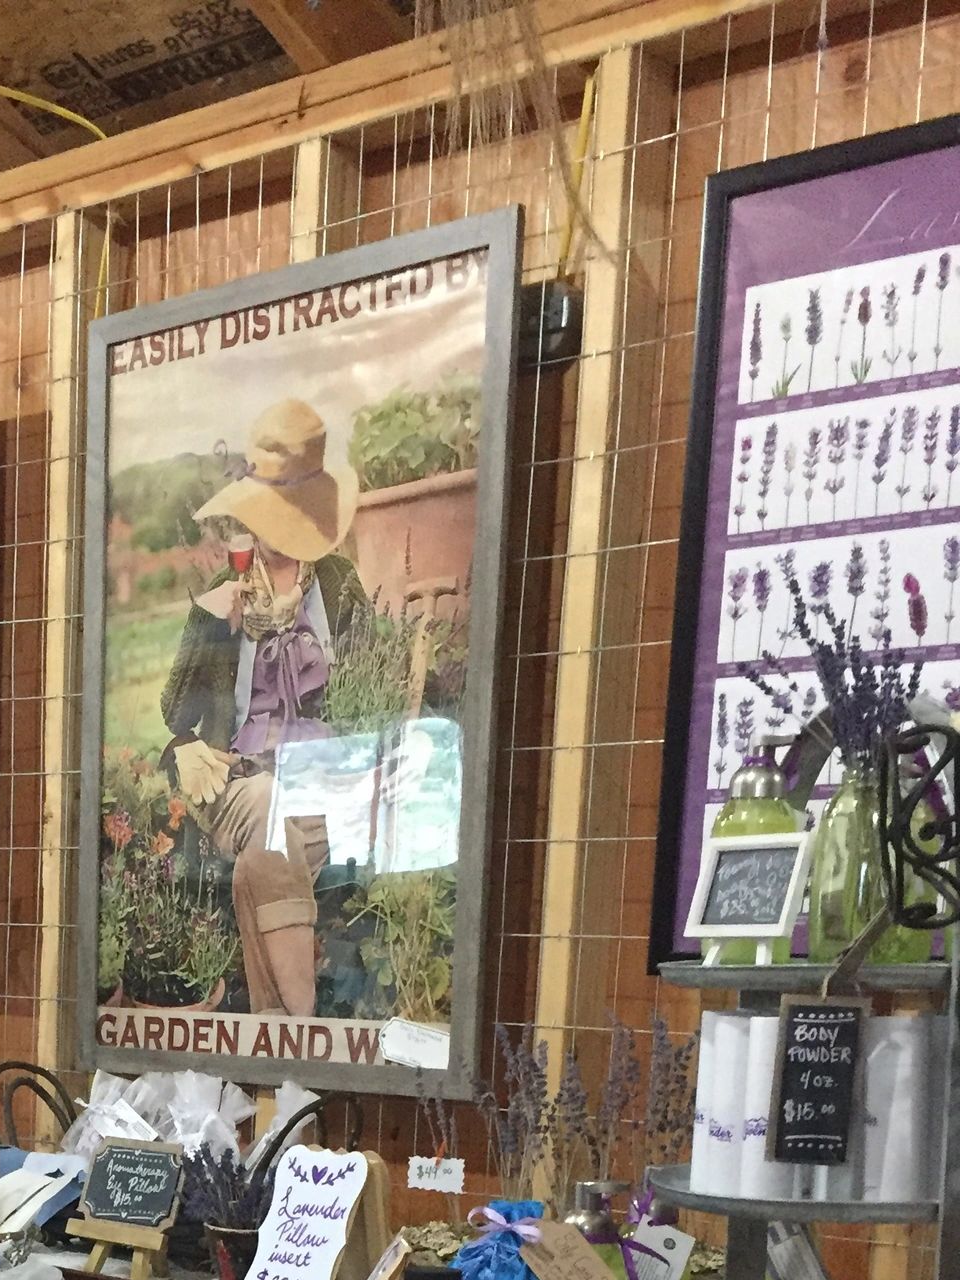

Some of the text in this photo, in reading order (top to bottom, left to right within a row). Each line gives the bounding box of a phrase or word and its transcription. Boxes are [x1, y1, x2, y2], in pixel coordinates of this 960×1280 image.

[111, 321, 210, 376] EASILY
[219, 266, 433, 350] DISTRACTED
[95, 1013, 240, 1054] GARDEN
[250, 1022, 334, 1062] AND
[794, 1024, 840, 1047] BODY
[788, 1046, 852, 1064] POWDER
[106, 1158, 169, 1188] Aromatherapy
[128, 1176, 166, 1194] Pillow
[278, 1186, 347, 1220] Lavender
[276, 1219, 329, 1247] Pillow
[268, 1244, 312, 1267] insert
